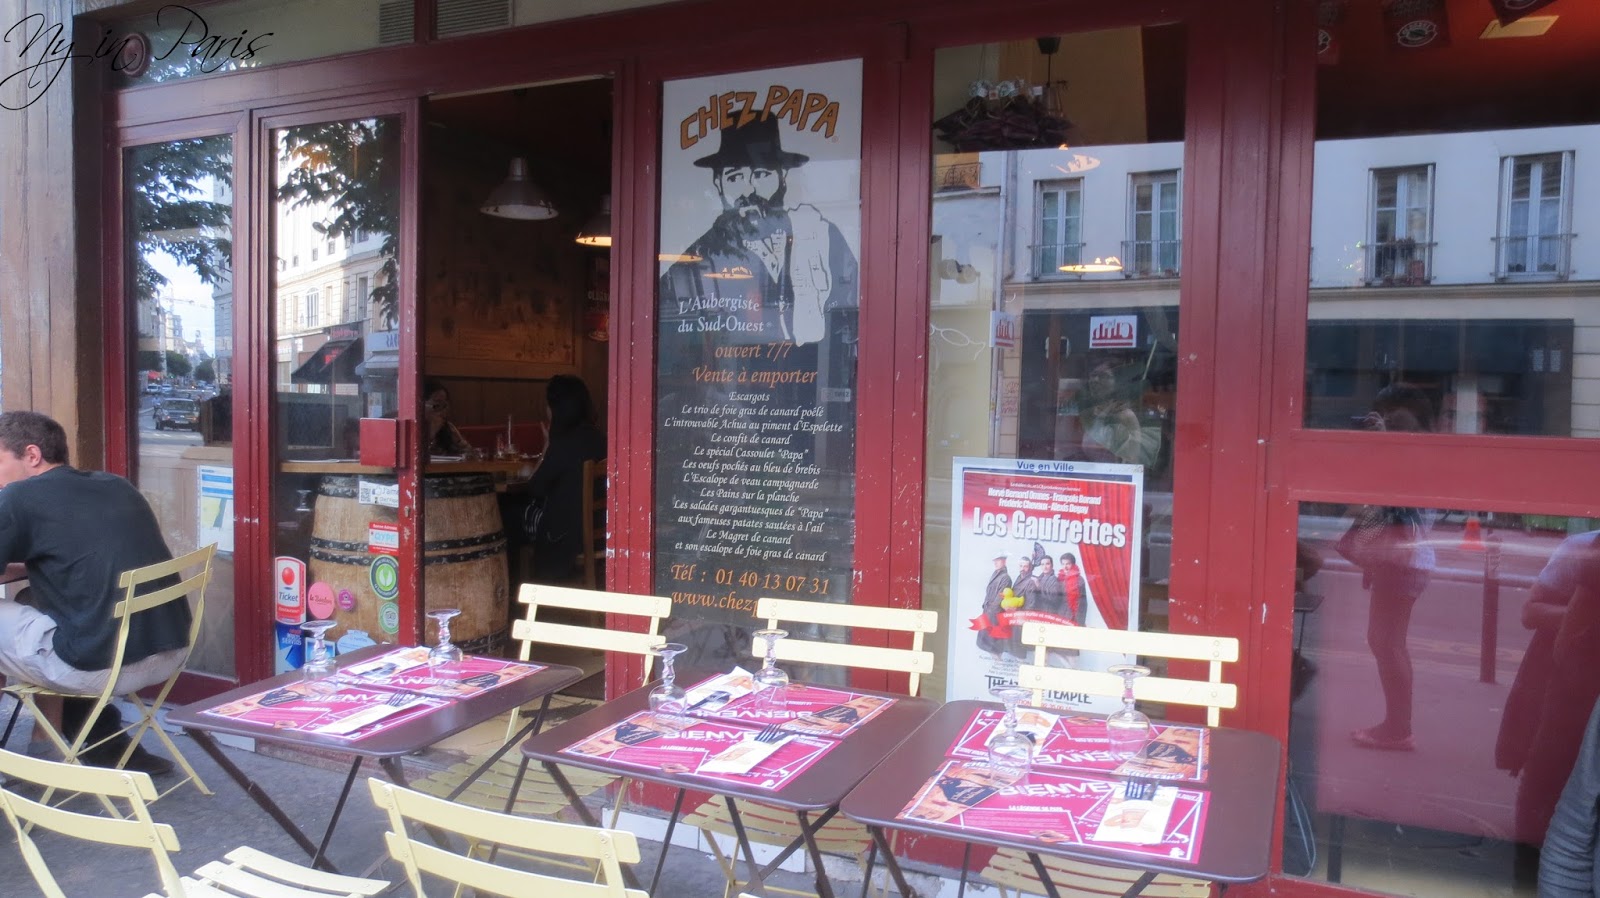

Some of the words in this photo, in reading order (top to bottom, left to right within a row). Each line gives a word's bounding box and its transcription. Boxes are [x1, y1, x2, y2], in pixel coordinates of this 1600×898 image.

[680, 91, 757, 150] CHEZ
[760, 85, 839, 138] PAPA
[678, 293, 760, 315] L'Aubergiste
[678, 320, 693, 333] du
[697, 316, 764, 332] Sud-Ouest
[715, 345, 761, 358] ouvert
[766, 341, 793, 361] 7/7
[692, 366, 733, 382] Vente
[738, 367, 746, 382] à
[751, 369, 818, 388] emporter
[729, 392, 770, 403] Escargots
[682, 405, 690, 413] Le
[692, 405, 708, 414] trio
[711, 406, 720, 414] de
[720, 405, 737, 417] foie
[739, 407, 756, 417] gras
[758, 406, 768, 415] de
[770, 406, 801, 416] canard
[664, 417, 718, 428] L'introuvable
[749, 422, 760, 430] au
[762, 421, 791, 432] piment
[711, 434, 722, 442] Le
[723, 434, 747, 445] confit
[750, 435, 760, 443] de
[762, 435, 792, 445] canard
[694, 447, 704, 455] Le
[706, 445, 733, 458] spécial
[736, 448, 775, 458] Cassoulet
[682, 459, 696, 469] Les
[698, 460, 720, 471] oeufs
[721, 461, 748, 473] pochés
[763, 462, 780, 473] bleu
[783, 464, 793, 473] de
[795, 464, 821, 475] brebis
[1017, 461, 1034, 470] Vue
[1038, 463, 1050, 471] en
[1053, 462, 1074, 472] Ville
[729, 475, 739, 484] de
[741, 478, 761, 486] veau
[763, 478, 819, 490] campagnarde
[700, 488, 714, 497] Les
[716, 489, 739, 498] Pains
[741, 491, 755, 499] sur
[757, 490, 765, 500] la
[766, 491, 800, 504] planche
[674, 500, 688, 509] Les
[690, 501, 718, 511] salades
[720, 505, 783, 517] gargantuesques
[785, 507, 795, 516] de
[678, 515, 695, 526] aux
[692, 516, 730, 526] fameuses
[732, 519, 763, 530] patates
[765, 521, 795, 531] sautées
[798, 522, 803, 531] à
[972, 507, 1008, 537] Les
[1012, 510, 1127, 548] Gaufrettes
[706, 530, 716, 539] Le
[719, 530, 748, 543] Magret
[751, 532, 761, 542] de
[763, 534, 793, 545] canard
[675, 542, 683, 550] et
[685, 543, 698, 551] son
[700, 543, 732, 555] escalope
[735, 545, 744, 554] de
[744, 545, 762, 558] foie
[763, 549, 781, 559] gras
[783, 549, 793, 559] de
[795, 551, 827, 562] canard
[671, 564, 696, 581] Tél
[716, 569, 733, 585] 01
[739, 572, 758, 587] 40
[763, 574, 781, 590] 13
[786, 576, 806, 591] 07
[810, 578, 829, 594] 31
[279, 591, 298, 602] Ticket
